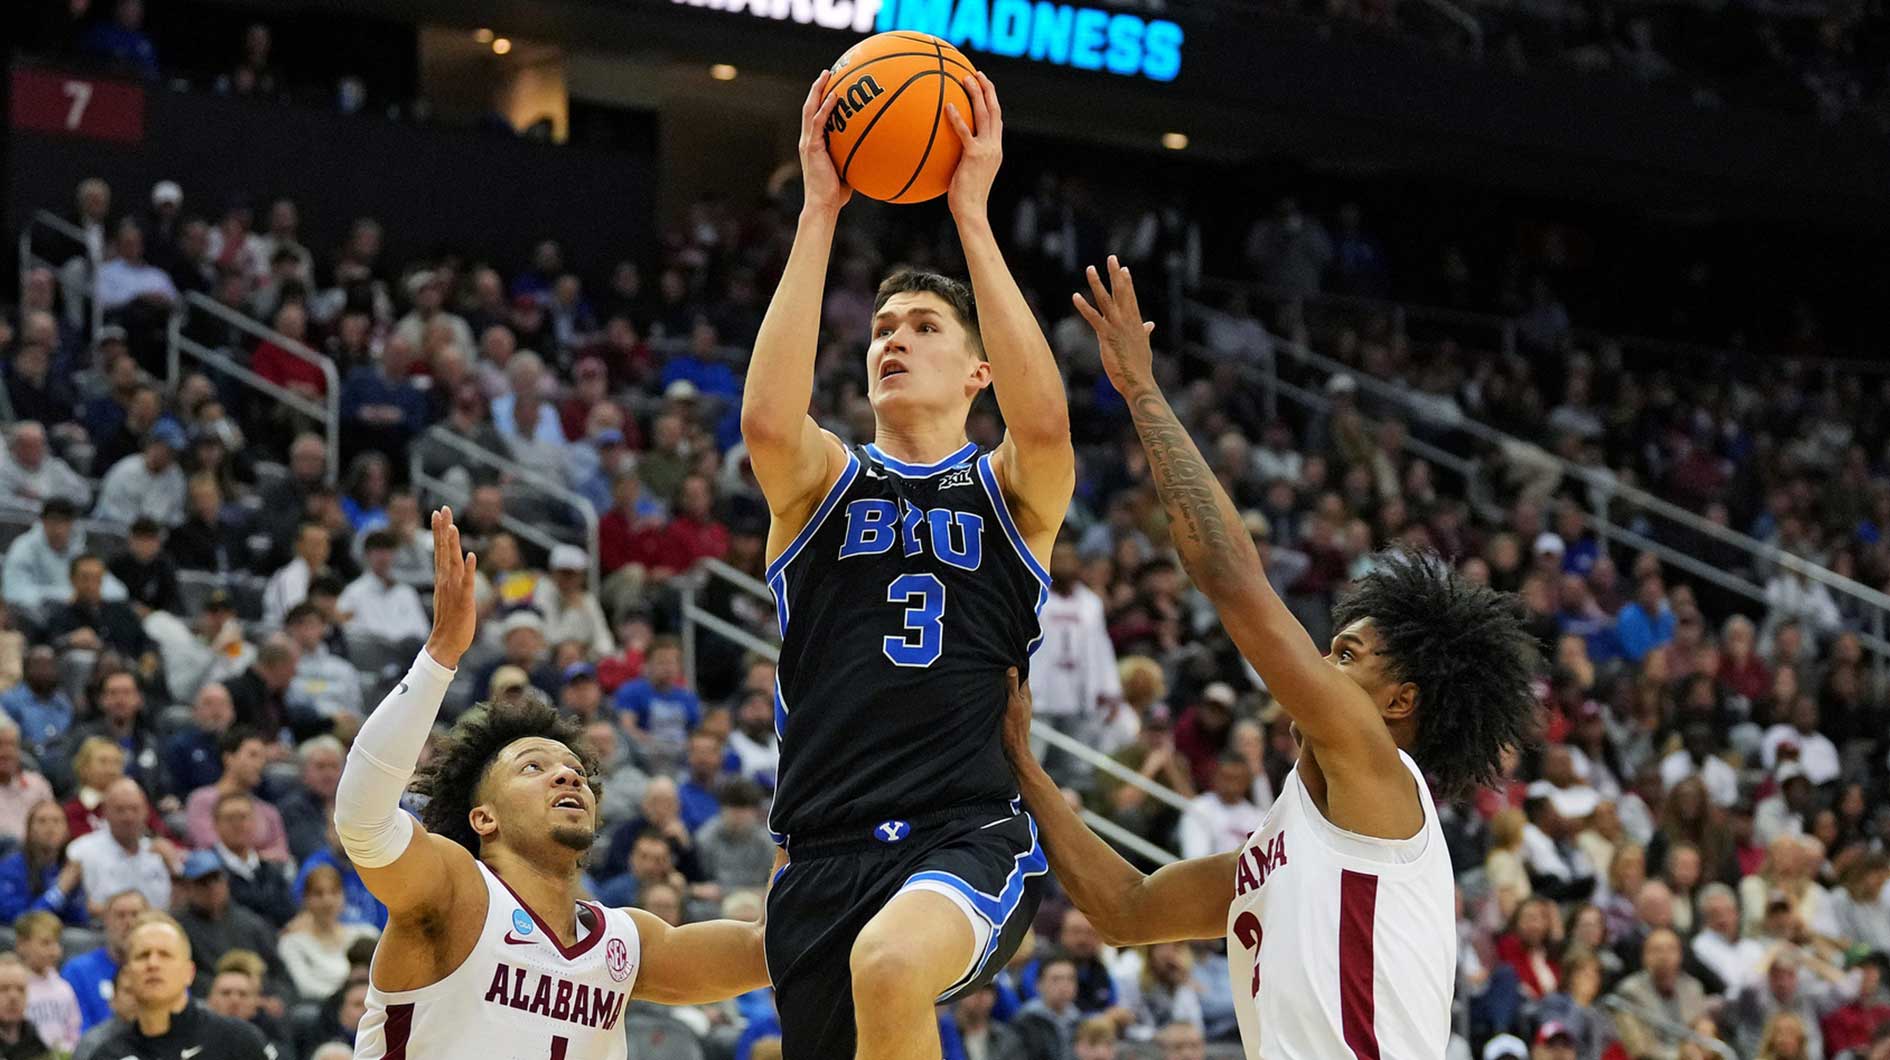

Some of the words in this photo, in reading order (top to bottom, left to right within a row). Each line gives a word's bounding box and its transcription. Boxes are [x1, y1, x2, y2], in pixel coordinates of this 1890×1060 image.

[63, 80, 94, 130] 7
[838, 497, 984, 571] BYU
[883, 573, 946, 668] 3
[879, 821, 904, 841] Y
[484, 962, 625, 1031] ALABAMA
